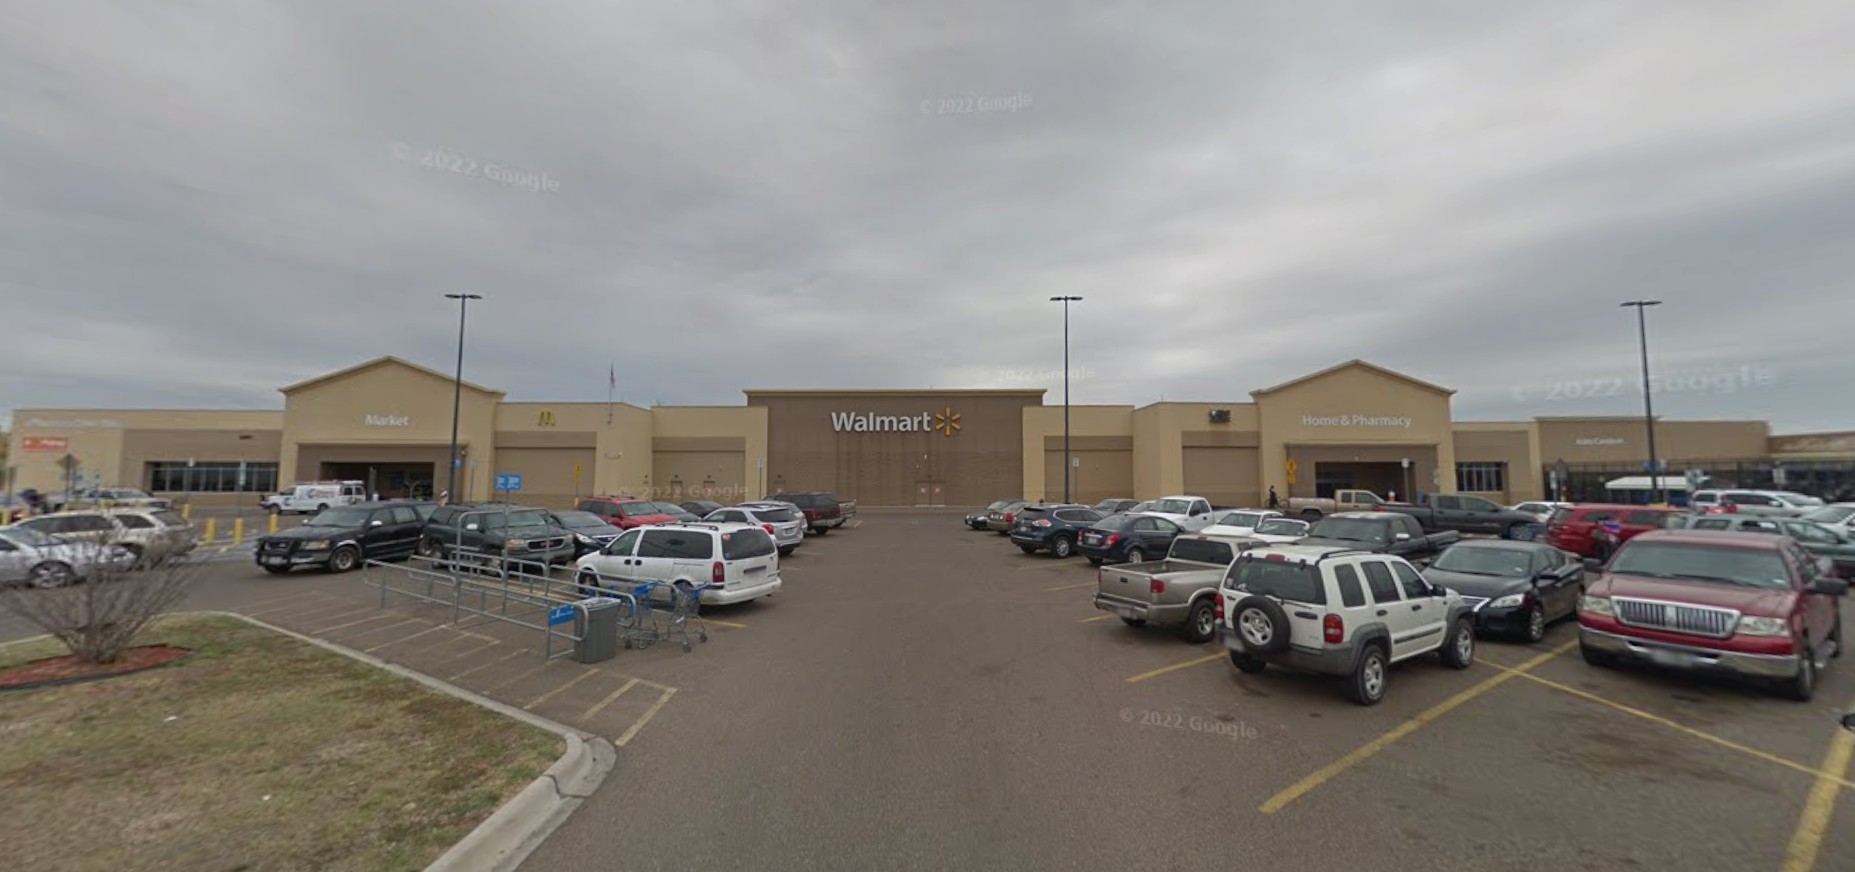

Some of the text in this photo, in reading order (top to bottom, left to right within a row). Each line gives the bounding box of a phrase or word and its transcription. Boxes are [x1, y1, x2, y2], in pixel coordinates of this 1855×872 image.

[365, 414, 409, 427] Market
[830, 410, 932, 432] Walmart
[1302, 413, 1412, 428] Home & Pharmacy
